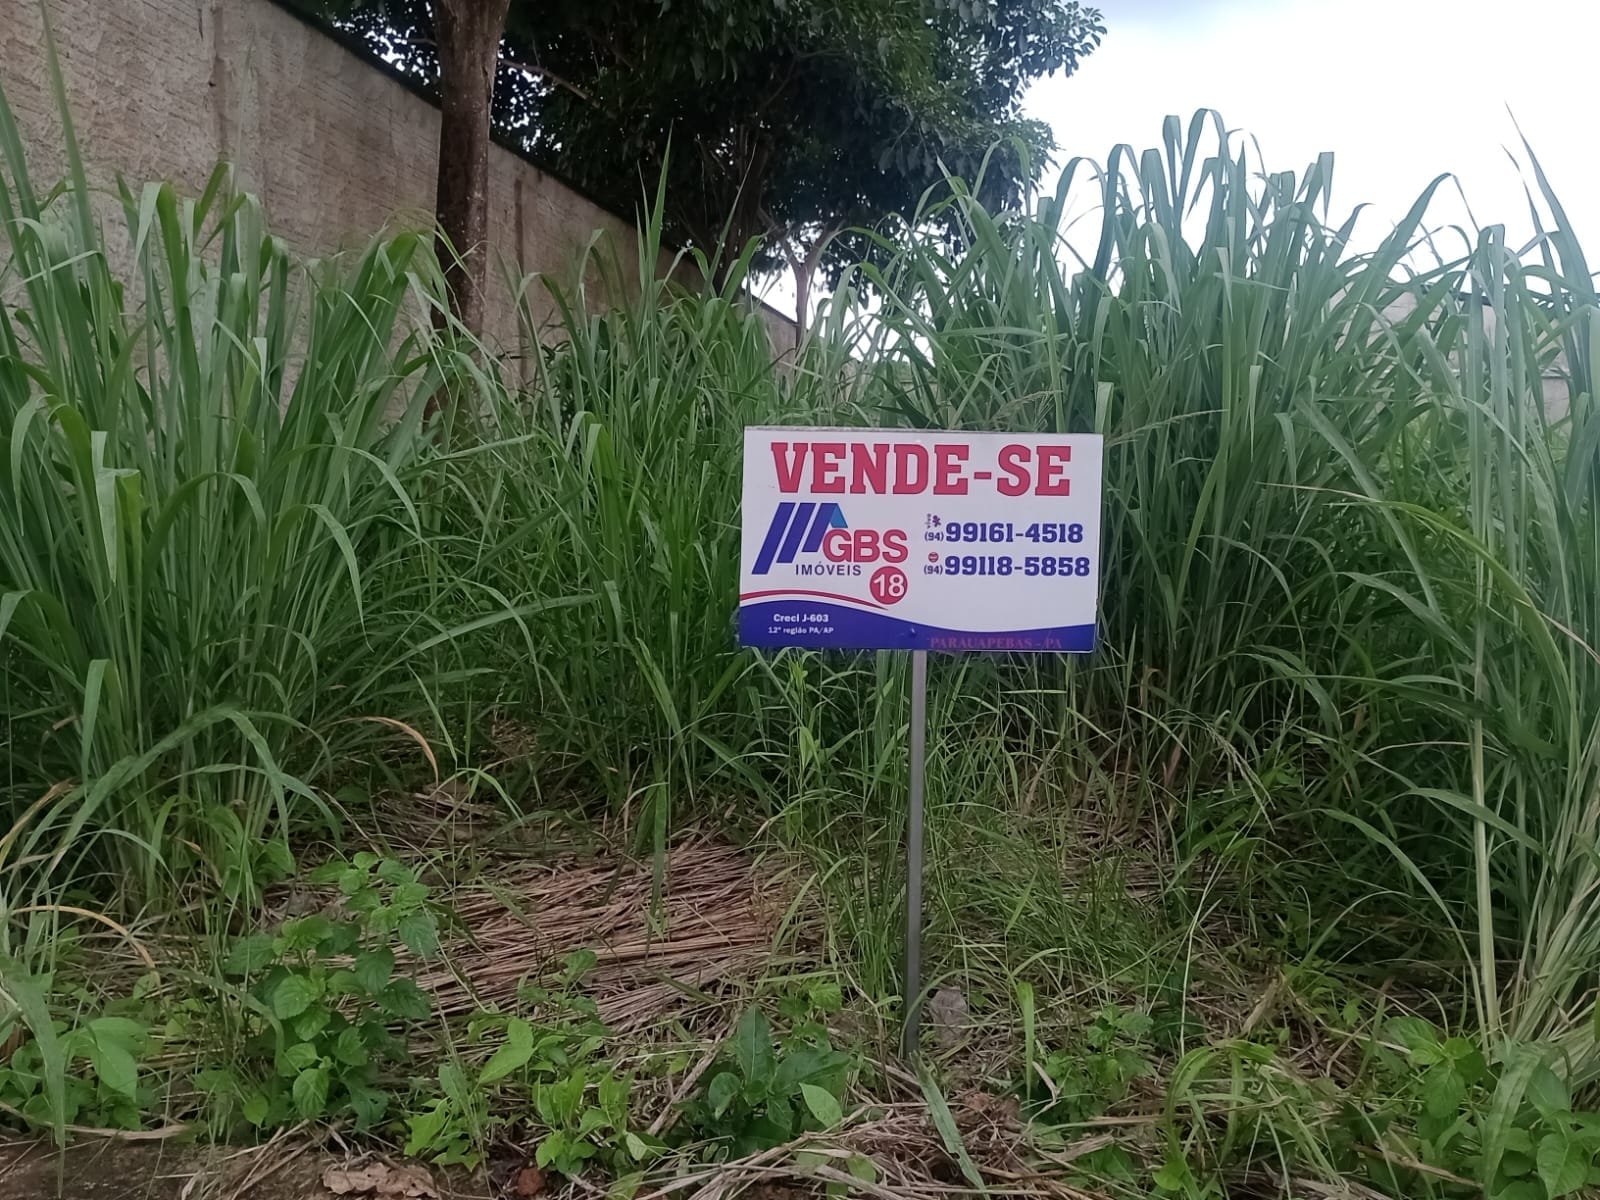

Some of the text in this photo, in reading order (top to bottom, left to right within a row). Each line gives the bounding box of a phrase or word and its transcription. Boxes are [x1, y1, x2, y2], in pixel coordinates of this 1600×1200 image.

[771, 442, 1071, 496] VENDE-SE
[924, 522, 1083, 543] (94) 99161-4518
[823, 528, 908, 563] GBS
[795, 561, 862, 576] IMÓVEIS
[923, 555, 1090, 577] (94) 99118-5858
[873, 574, 905, 597] 18
[773, 613, 829, 623] Creci J-603
[808, 626, 834, 635] PA/AP
[930, 637, 1033, 649] PARAUAPEBAS
